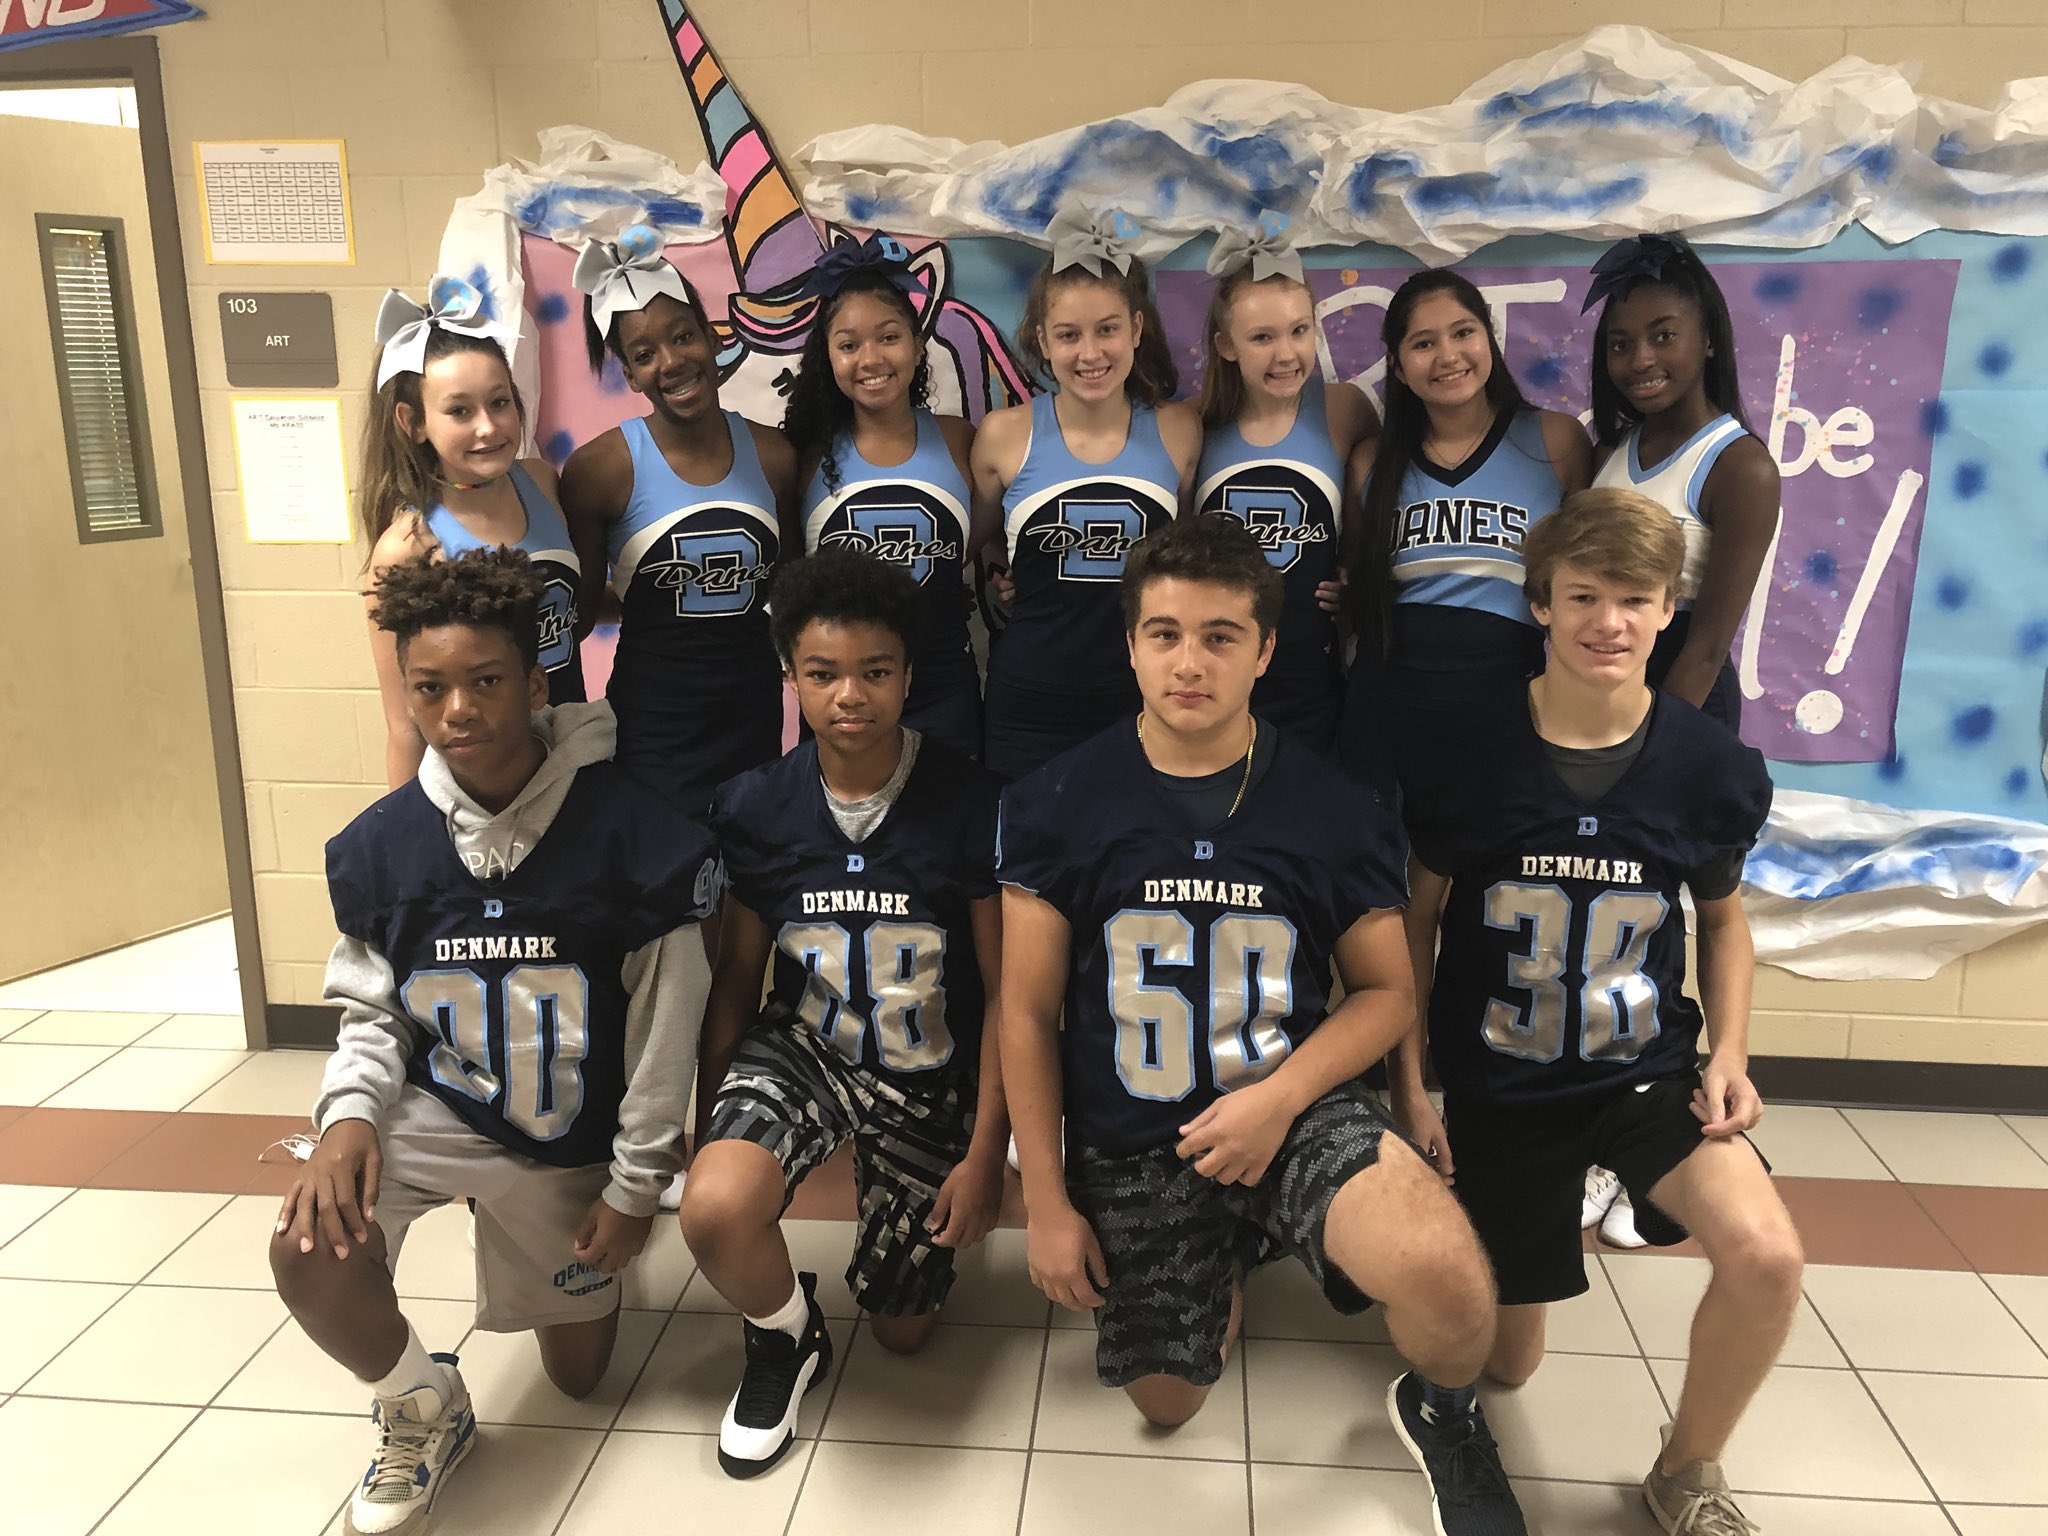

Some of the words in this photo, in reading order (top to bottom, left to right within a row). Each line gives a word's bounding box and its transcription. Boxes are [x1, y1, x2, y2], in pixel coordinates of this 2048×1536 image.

[227, 298, 258, 314] 103
[265, 335, 290, 347] ART
[1768, 334, 1875, 479] be
[1025, 523, 1142, 553] Dan
[1058, 499, 1147, 582] D
[1389, 497, 1529, 556] ANES
[671, 527, 762, 618] D
[1577, 816, 1598, 836] D
[846, 854, 865, 873] D
[1193, 841, 1214, 860] D
[1521, 855, 1643, 884] DENMARK
[801, 889, 910, 915] DENMARK
[1144, 878, 1264, 908] DENMARK
[483, 899, 504, 918] D
[434, 936, 557, 962] DENMARK
[1480, 880, 1671, 1065] 38
[1103, 908, 1298, 1102] 60
